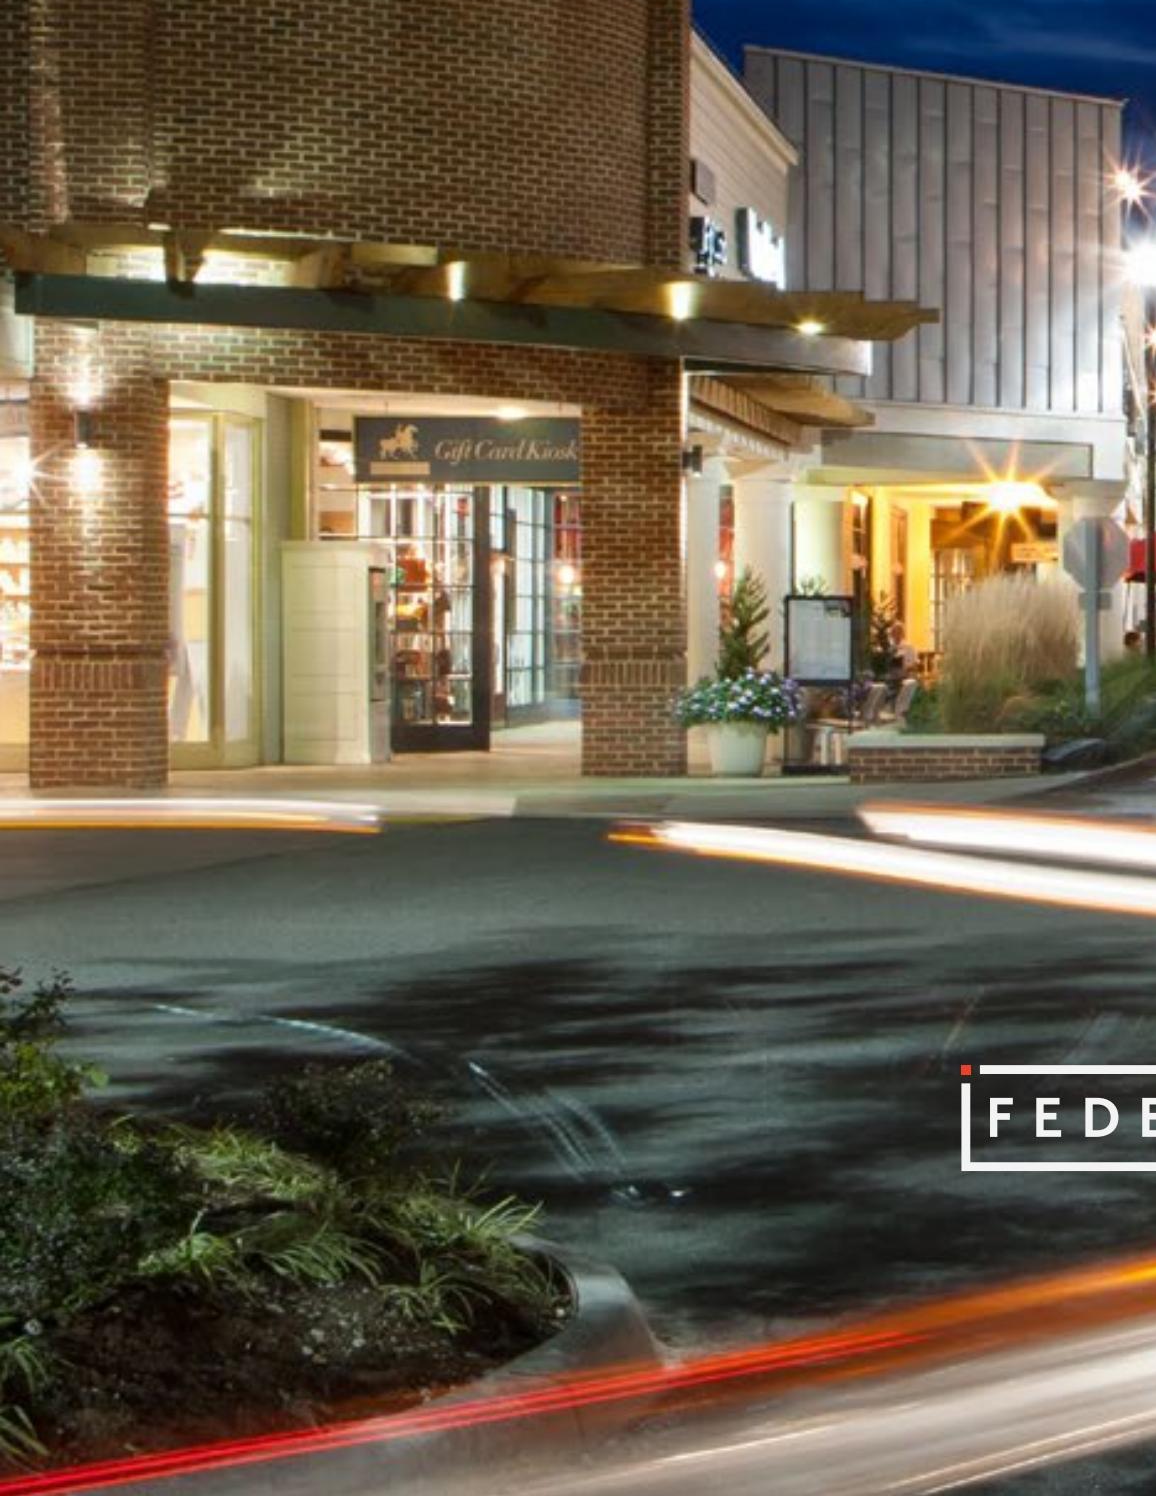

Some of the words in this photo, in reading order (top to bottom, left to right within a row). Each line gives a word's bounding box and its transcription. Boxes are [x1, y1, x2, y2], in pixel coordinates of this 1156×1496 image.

[434, 438, 473, 465] Gift
[474, 438, 526, 461] Card
[525, 437, 578, 461] Kiosk
